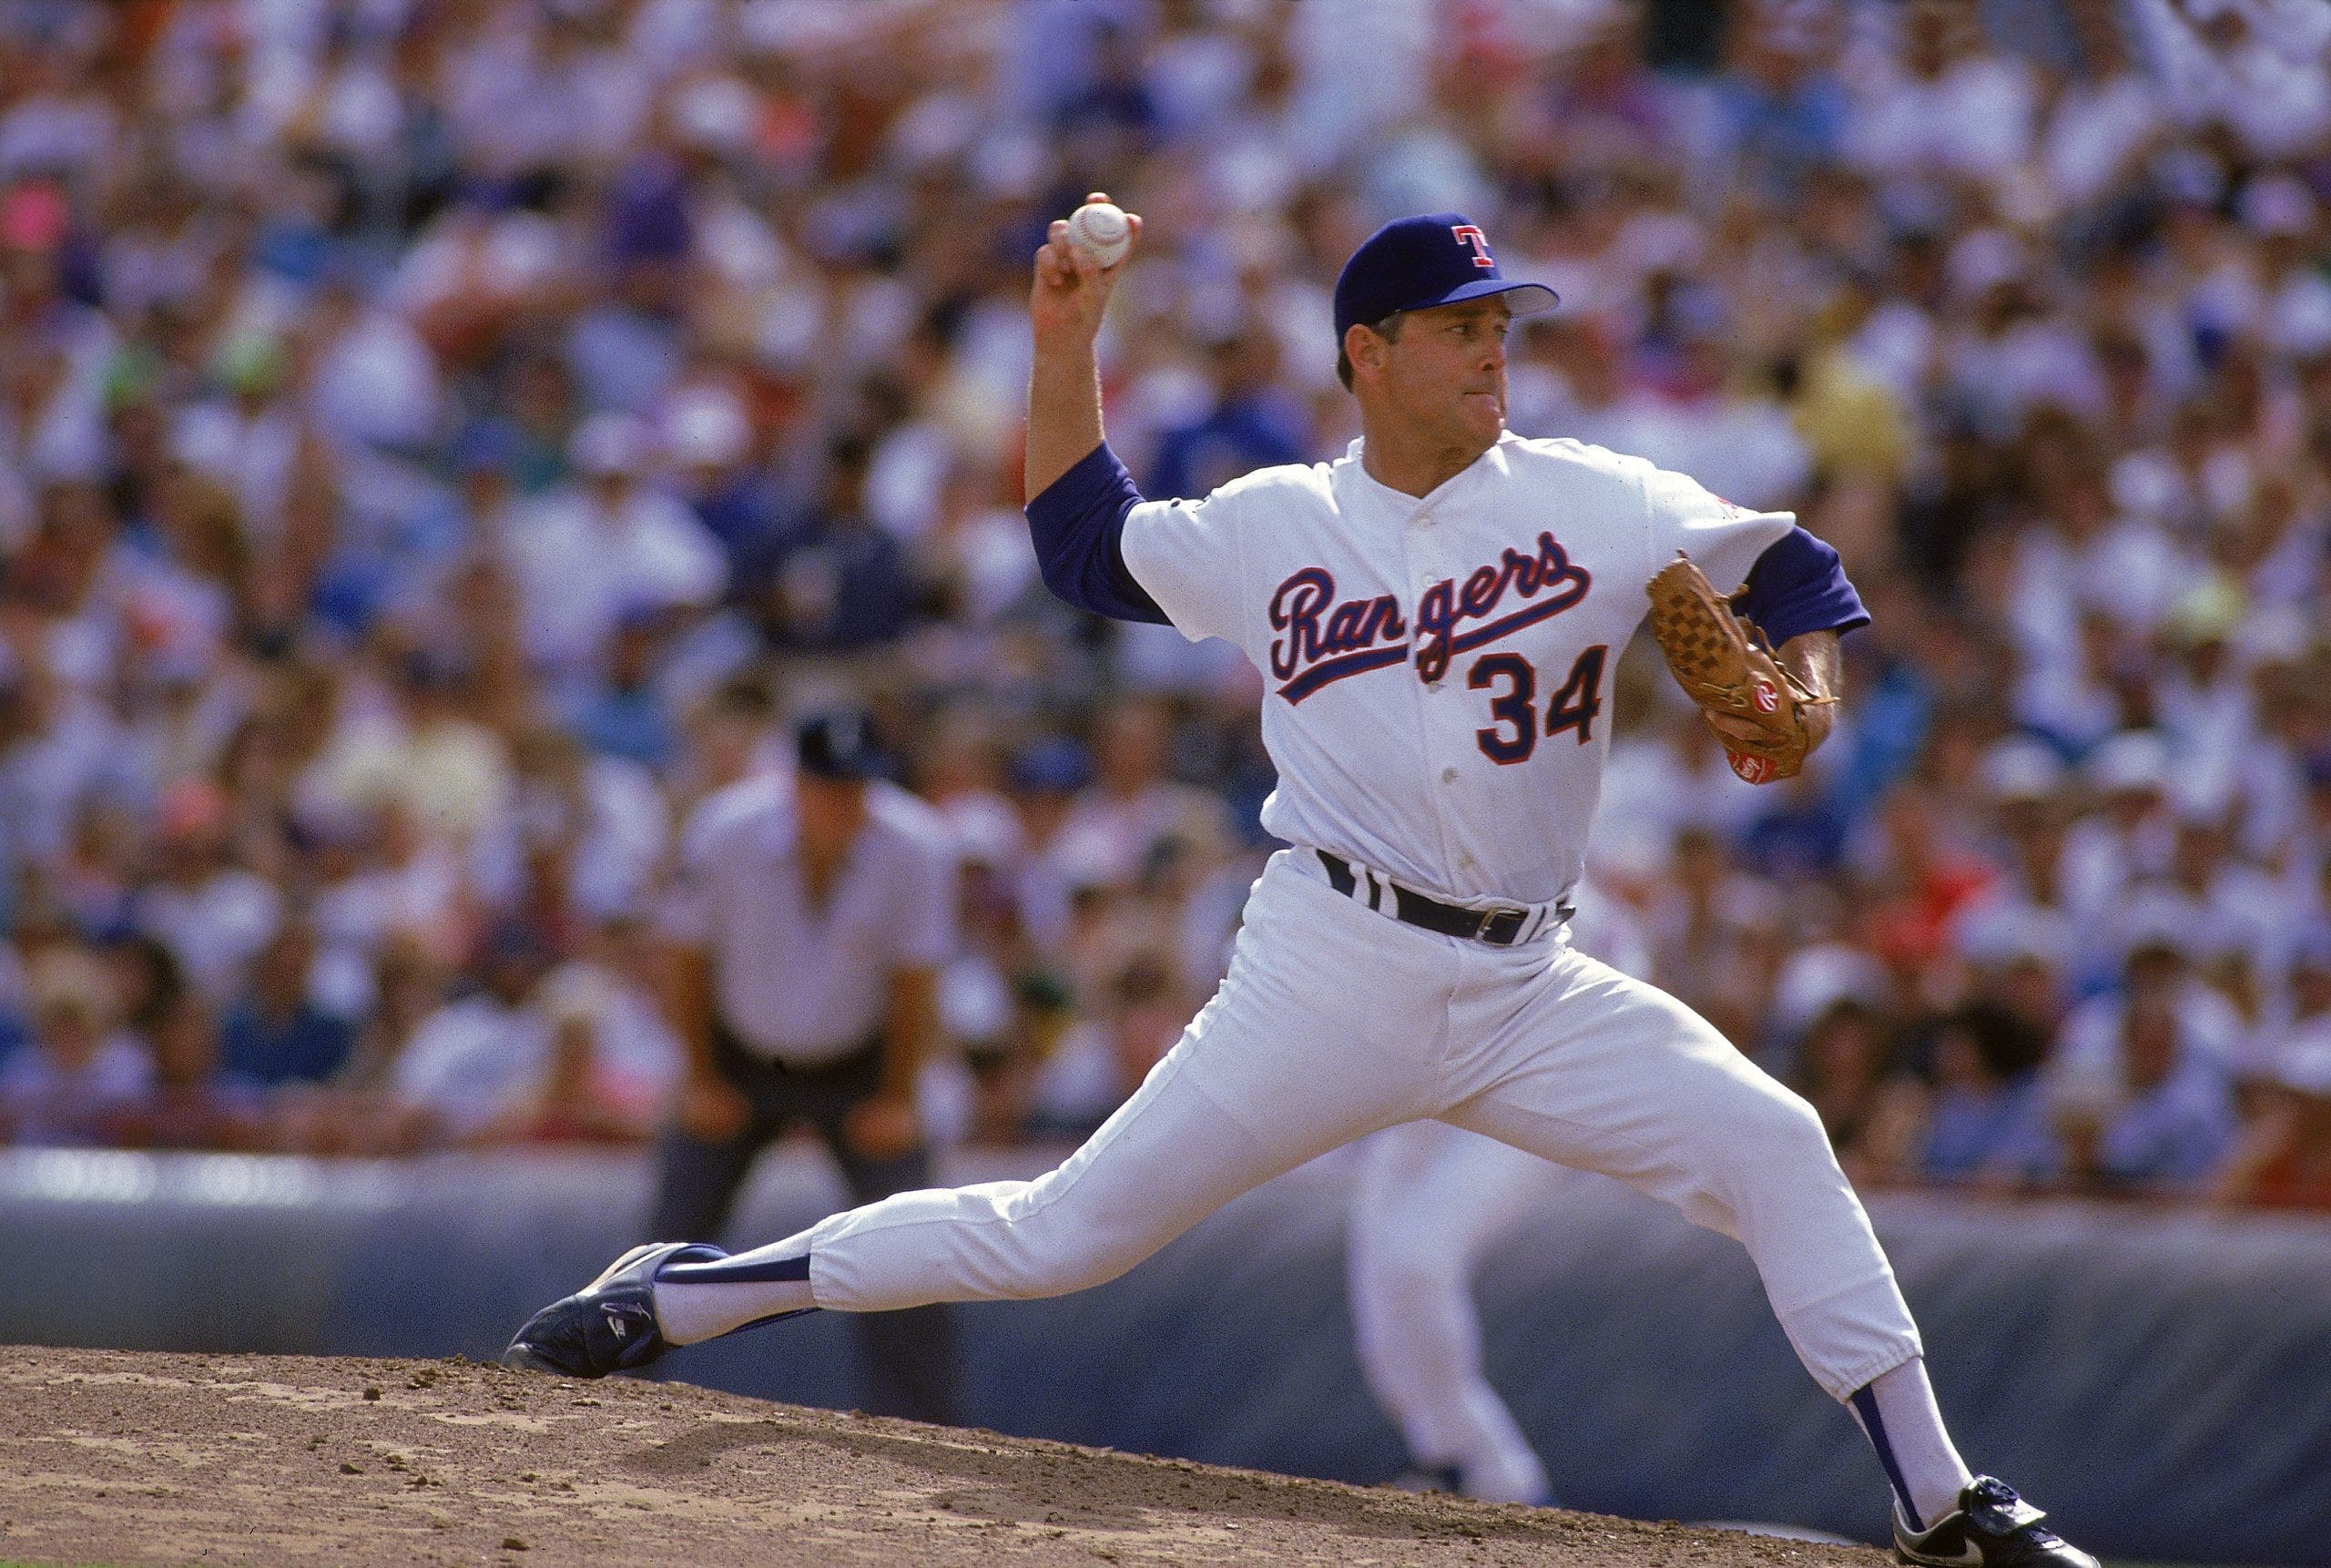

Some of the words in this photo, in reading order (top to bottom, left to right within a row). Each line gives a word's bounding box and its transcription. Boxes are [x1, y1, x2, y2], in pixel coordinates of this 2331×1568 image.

[1451, 225, 1494, 268] T
[1269, 531, 1591, 706] Rangers
[1467, 645, 1608, 766] 34
